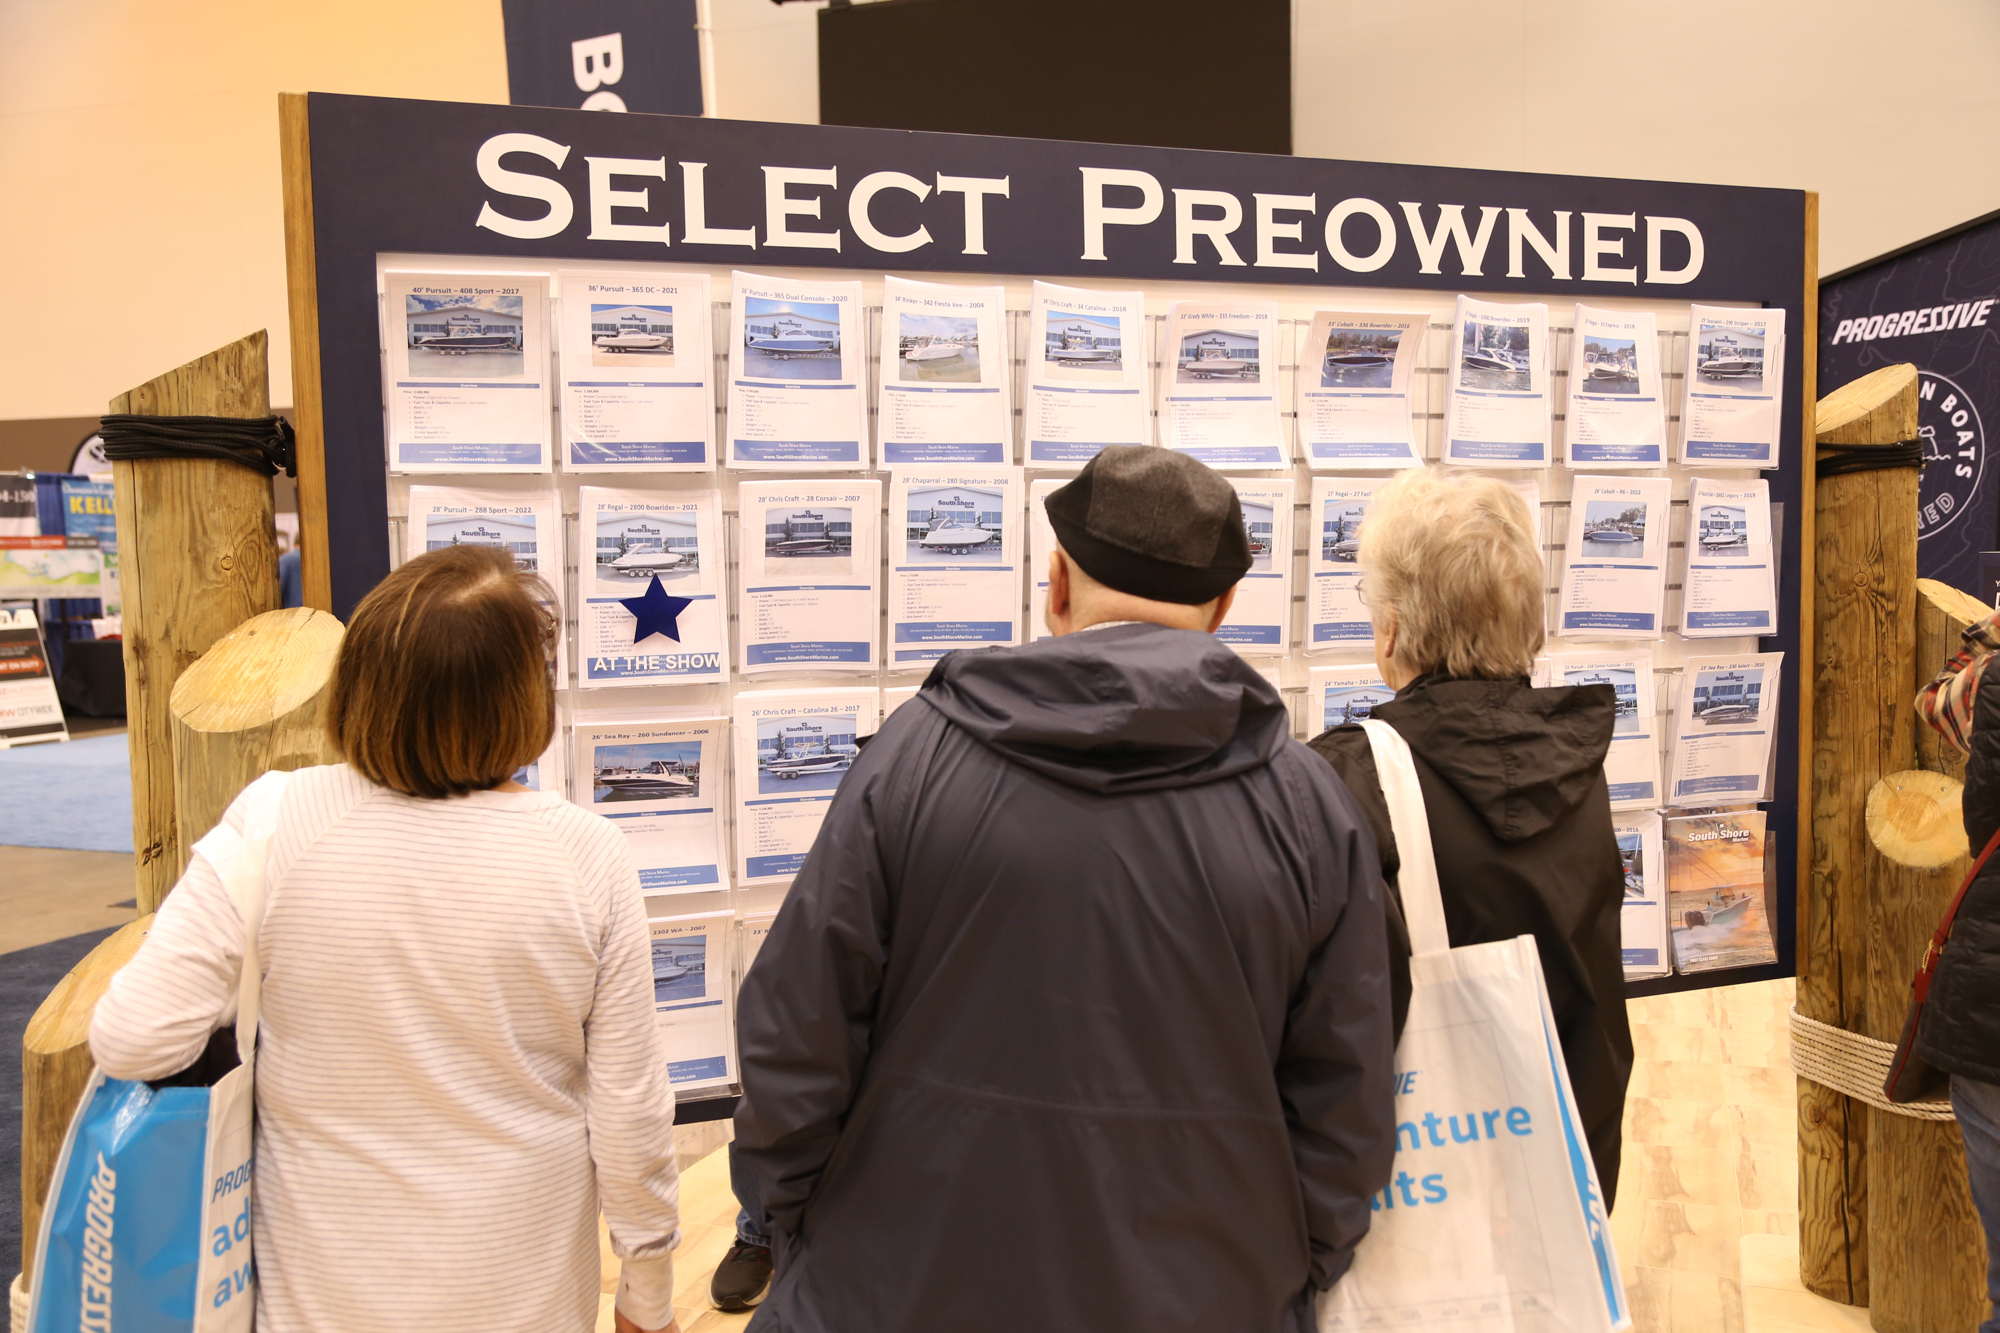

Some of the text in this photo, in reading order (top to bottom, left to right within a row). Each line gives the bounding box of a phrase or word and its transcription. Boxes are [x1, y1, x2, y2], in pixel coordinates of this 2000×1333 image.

[476, 132, 1705, 286] SELECT PREOWNED
[474, 288, 494, 296] Sport
[600, 285, 625, 293] Pursuit
[749, 289, 768, 297] Pursuit
[1832, 298, 1995, 345] PROGRESSIVE
[1940, 393, 1976, 479] BOATS
[912, 477, 941, 485] Chaparral
[69, 495, 116, 515] KELL
[488, 506, 508, 514] Sport
[607, 503, 624, 511] Regal
[593, 653, 721, 672] AT THE SHOW
[803, 706, 829, 714] Catalina
[1688, 828, 1750, 842] South Shore
[1396, 1106, 1533, 1152] nture
[212, 1157, 252, 1204] PROG
[213, 1196, 250, 1257] ad
[79, 1150, 117, 1333] PROGRESS
